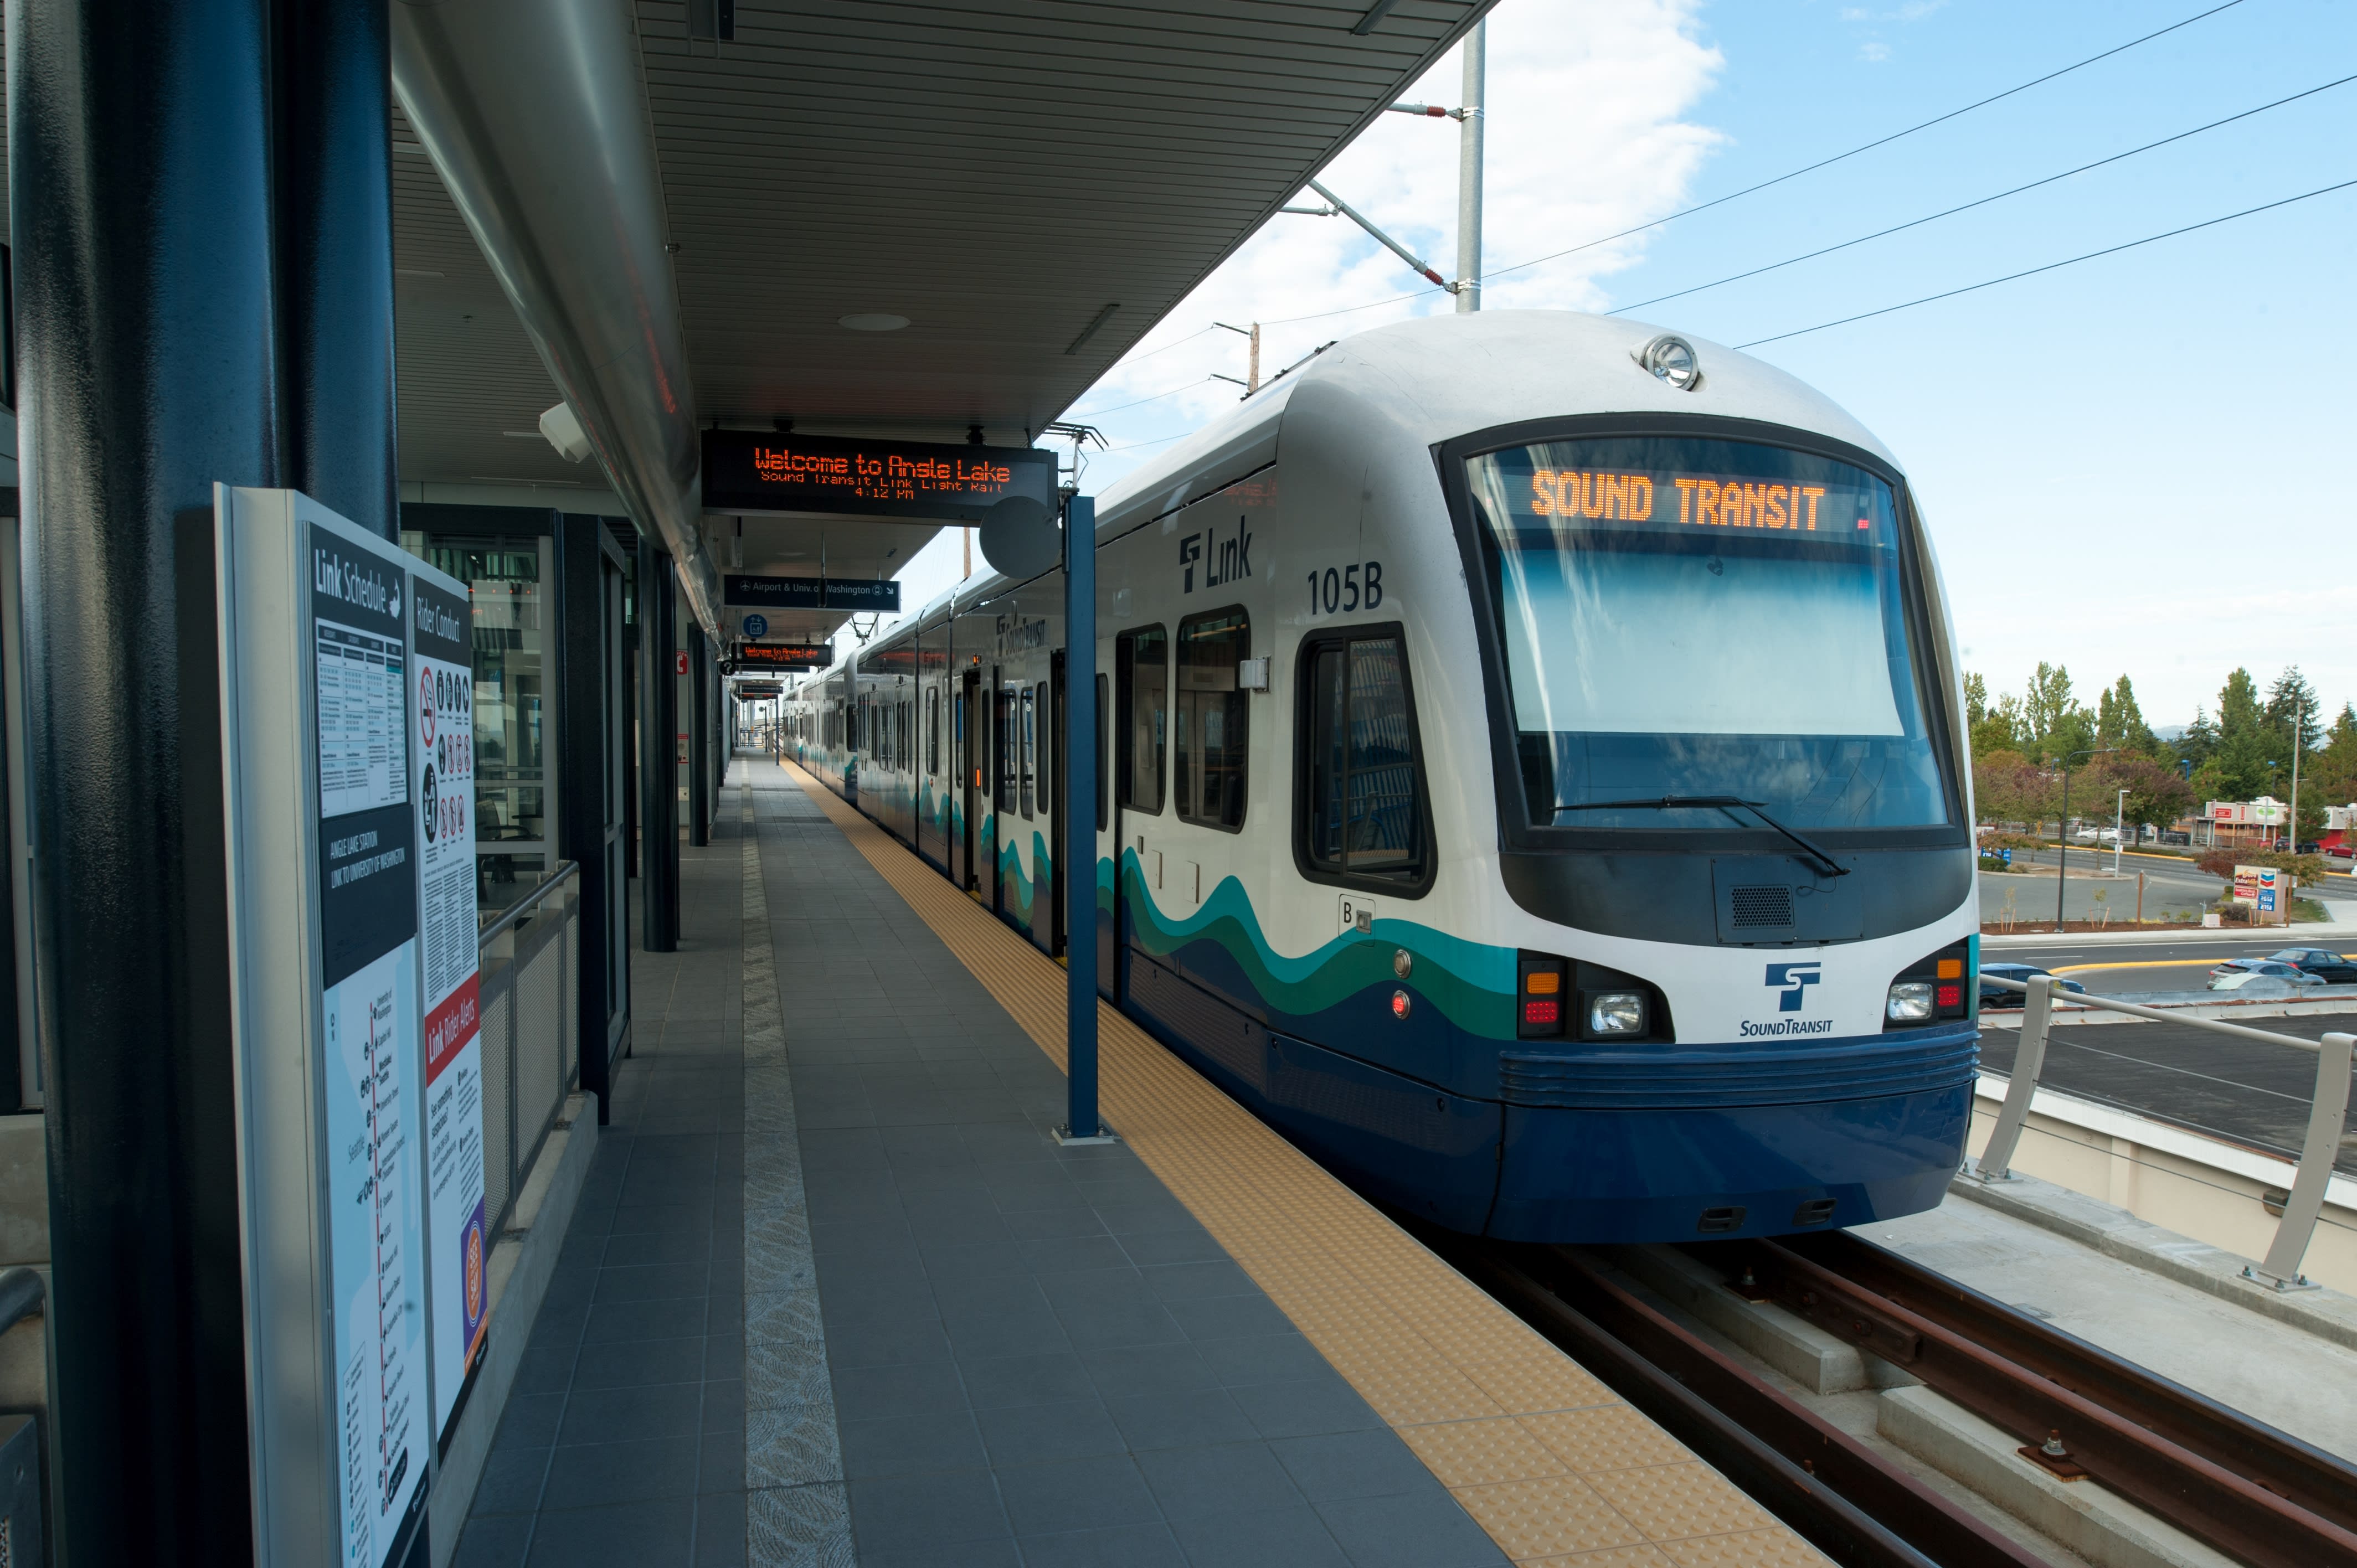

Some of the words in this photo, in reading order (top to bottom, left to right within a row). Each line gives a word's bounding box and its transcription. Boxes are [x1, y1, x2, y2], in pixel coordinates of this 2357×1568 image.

[755, 448, 848, 473] Welcome
[856, 454, 881, 475] to
[957, 460, 1010, 482] Lake
[761, 471, 804, 483] Sound
[880, 477, 913, 488] Link
[855, 487, 888, 498] 4:12
[897, 489, 913, 500] PM
[1531, 470, 1653, 522] SOUND
[1675, 478, 1826, 530] TRANSIT
[1206, 514, 1252, 588] Link
[316, 549, 342, 599] Link
[344, 561, 386, 614] Schedule
[753, 581, 781, 592] Airport
[793, 584, 812, 592] Univ.
[1308, 561, 1383, 615] 105B
[417, 596, 435, 633] Rider
[436, 605, 460, 643] Conduct
[331, 838, 347, 860] ANGLE
[347, 835, 359, 855] LAKE
[359, 830, 378, 851] STATION
[331, 868, 343, 889] LINK
[343, 865, 350, 884] TO
[349, 857, 374, 881] UNIVERSITY
[374, 855, 380, 873] OF
[380, 847, 405, 870] WASHINGTON
[1344, 902, 1351, 923] B
[429, 1021, 444, 1065] Link
[444, 1009, 459, 1049] Rider
[460, 997, 475, 1032] Alerts
[349, 1133, 364, 1164] Seattle
